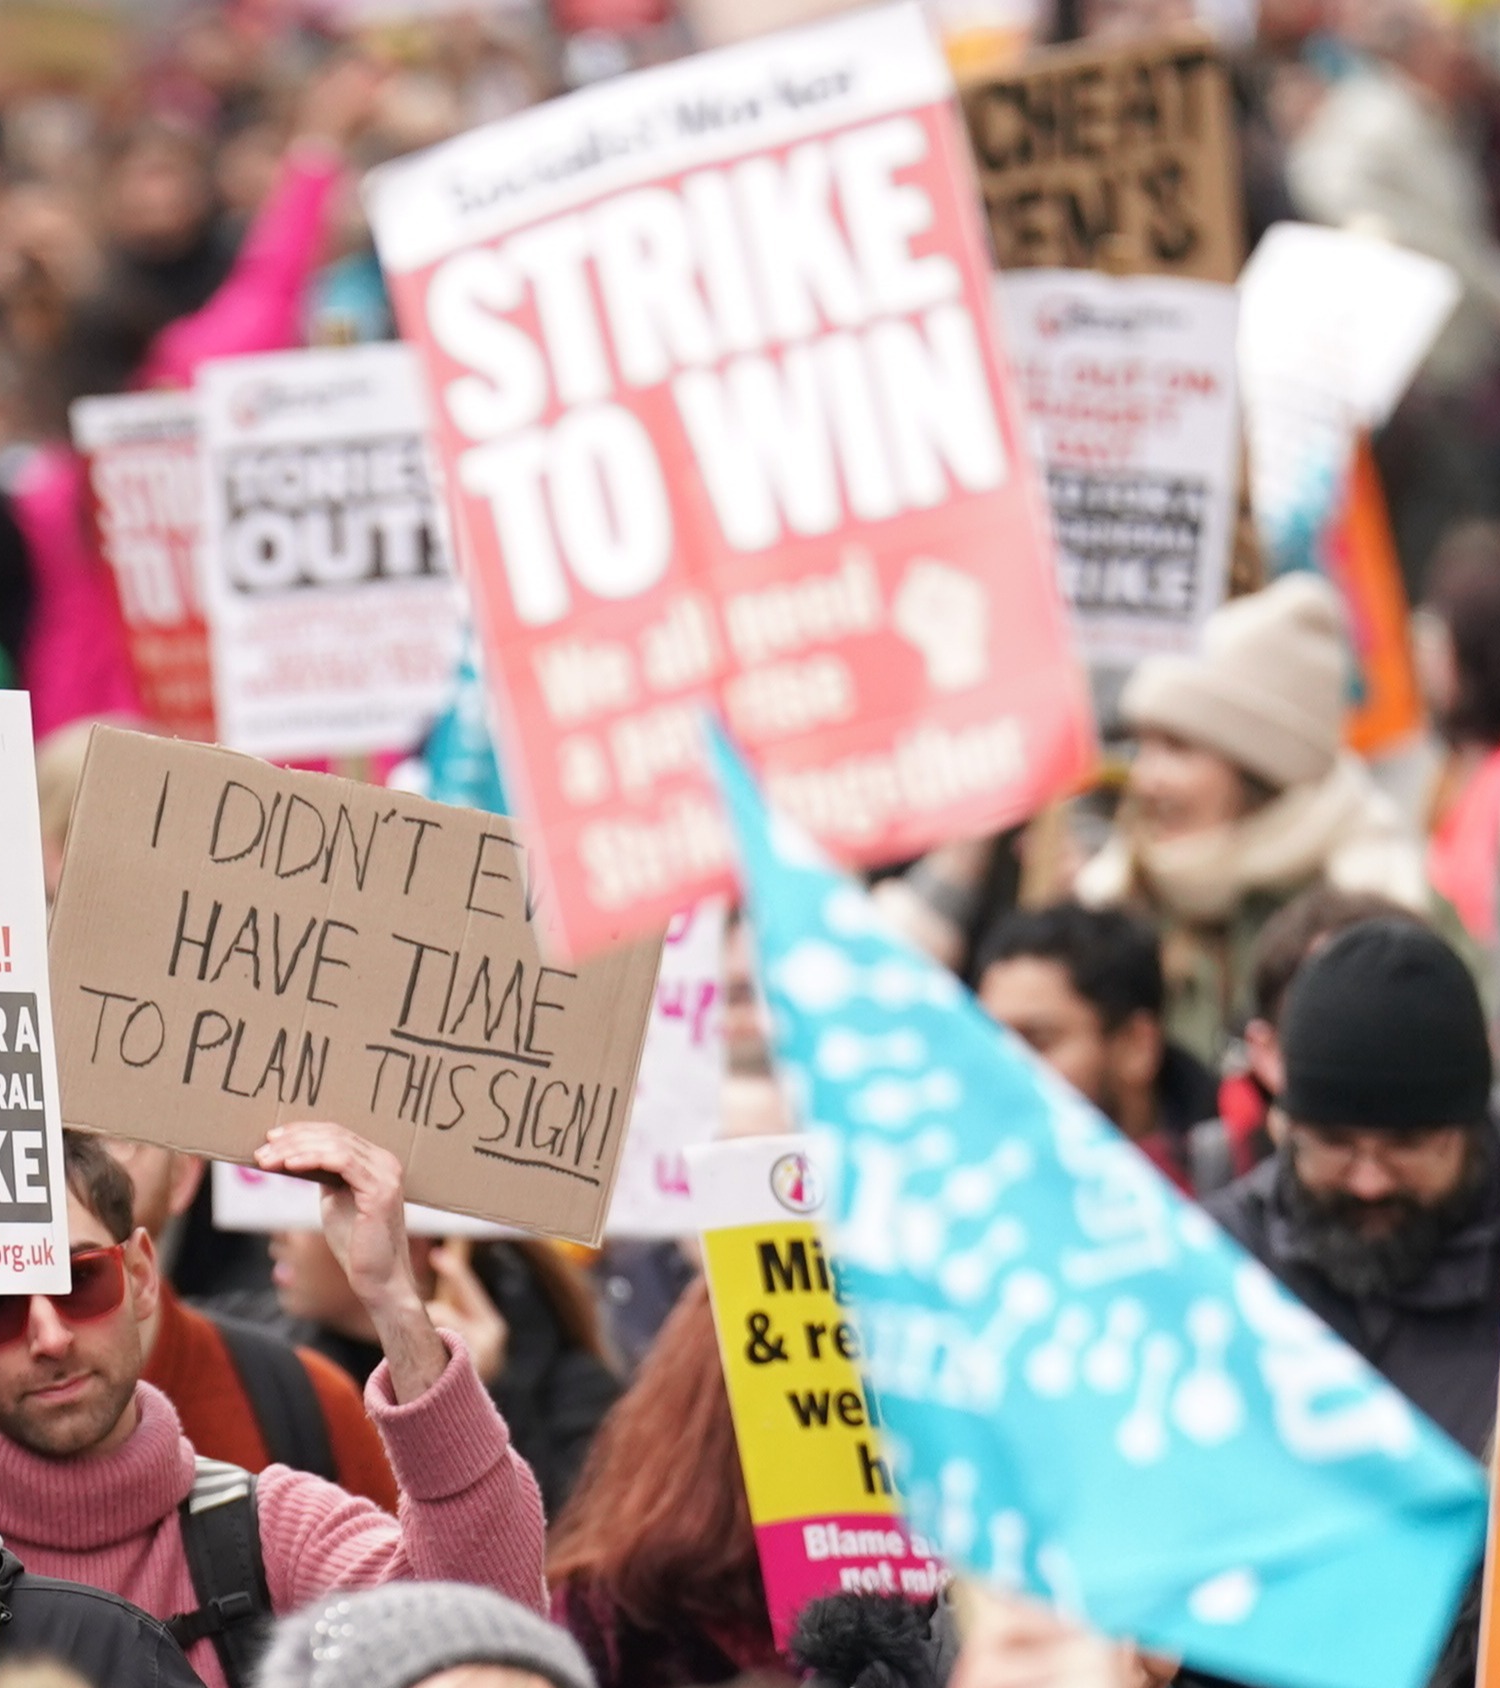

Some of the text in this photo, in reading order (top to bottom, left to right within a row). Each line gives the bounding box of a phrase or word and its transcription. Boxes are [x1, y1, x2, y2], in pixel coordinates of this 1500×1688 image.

[426, 114, 964, 443] STRIKE
[458, 303, 1008, 627] TO WIN
[151, 770, 171, 849] I
[209, 780, 443, 894] DIDN'T
[13, 1005, 39, 1053] A
[168, 890, 579, 1057] HAVE TIME
[79, 985, 618, 1170] TO PLAN THIS SIGN!
[744, 1310, 789, 1366] &
[801, 1521, 906, 1562] Blame
